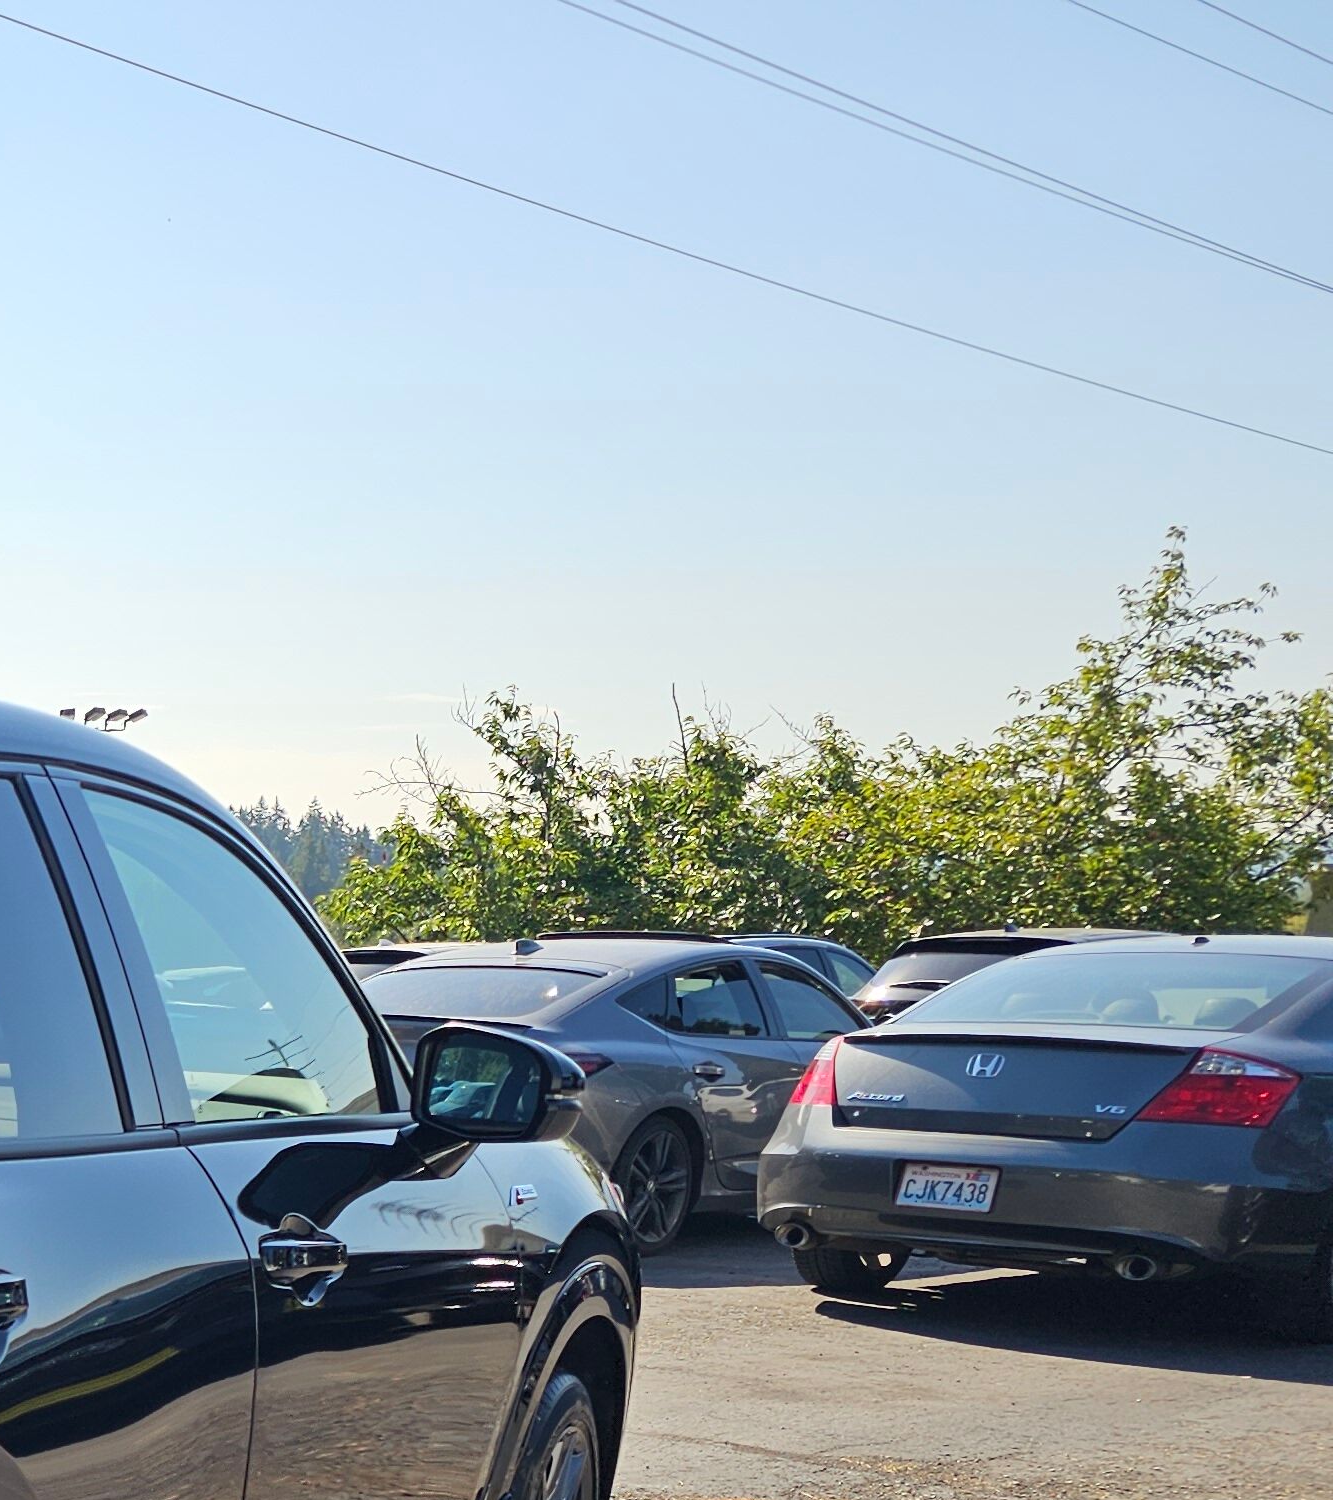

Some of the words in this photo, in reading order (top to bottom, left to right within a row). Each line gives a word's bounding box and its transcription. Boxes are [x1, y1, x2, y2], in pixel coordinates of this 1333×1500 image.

[846, 1091, 906, 1102] Accord
[1095, 1104, 1127, 1115] V6
[911, 1169, 962, 1179] WASHINGTON
[903, 1179, 989, 1204] CJK7438
